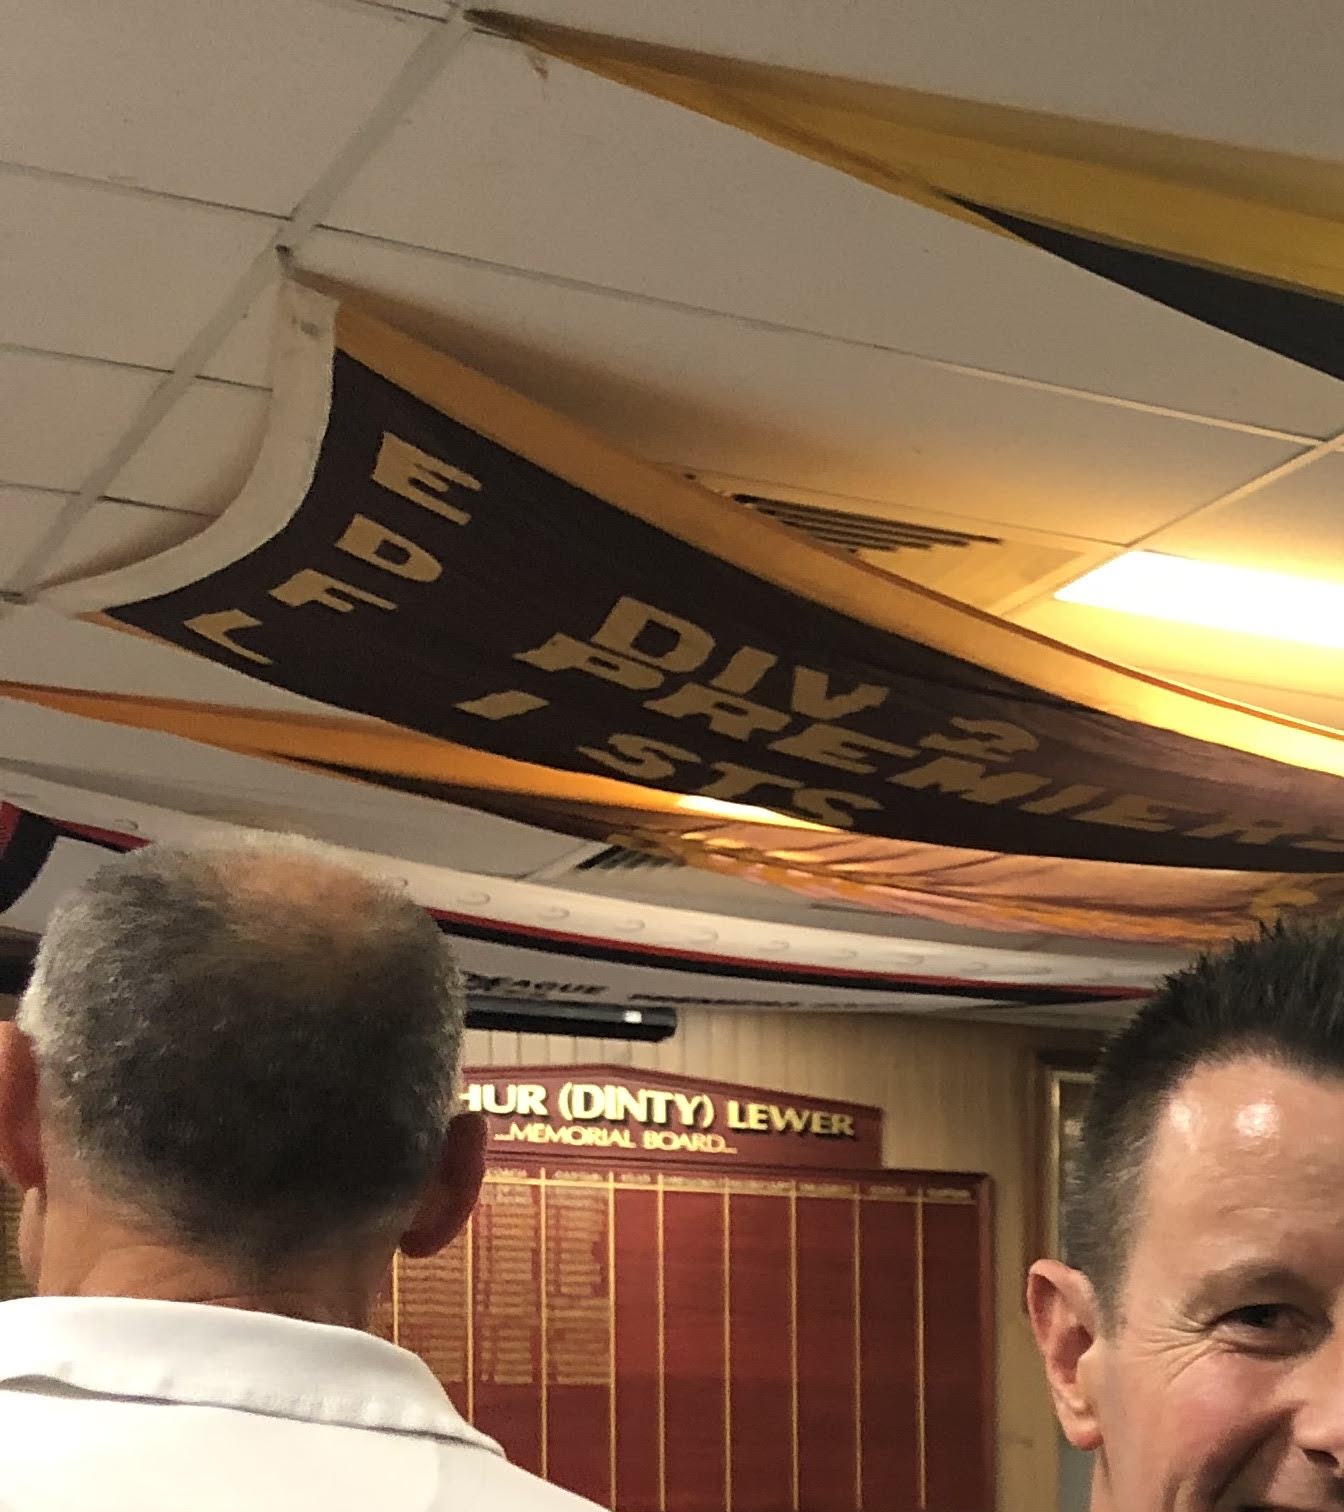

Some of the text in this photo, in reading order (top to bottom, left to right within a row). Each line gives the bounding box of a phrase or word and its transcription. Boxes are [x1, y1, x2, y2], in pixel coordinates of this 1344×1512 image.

[591, 596, 891, 722] DIV
[557, 1081, 714, 1128] (DINTY)
[727, 1099, 855, 1136] LEWER
